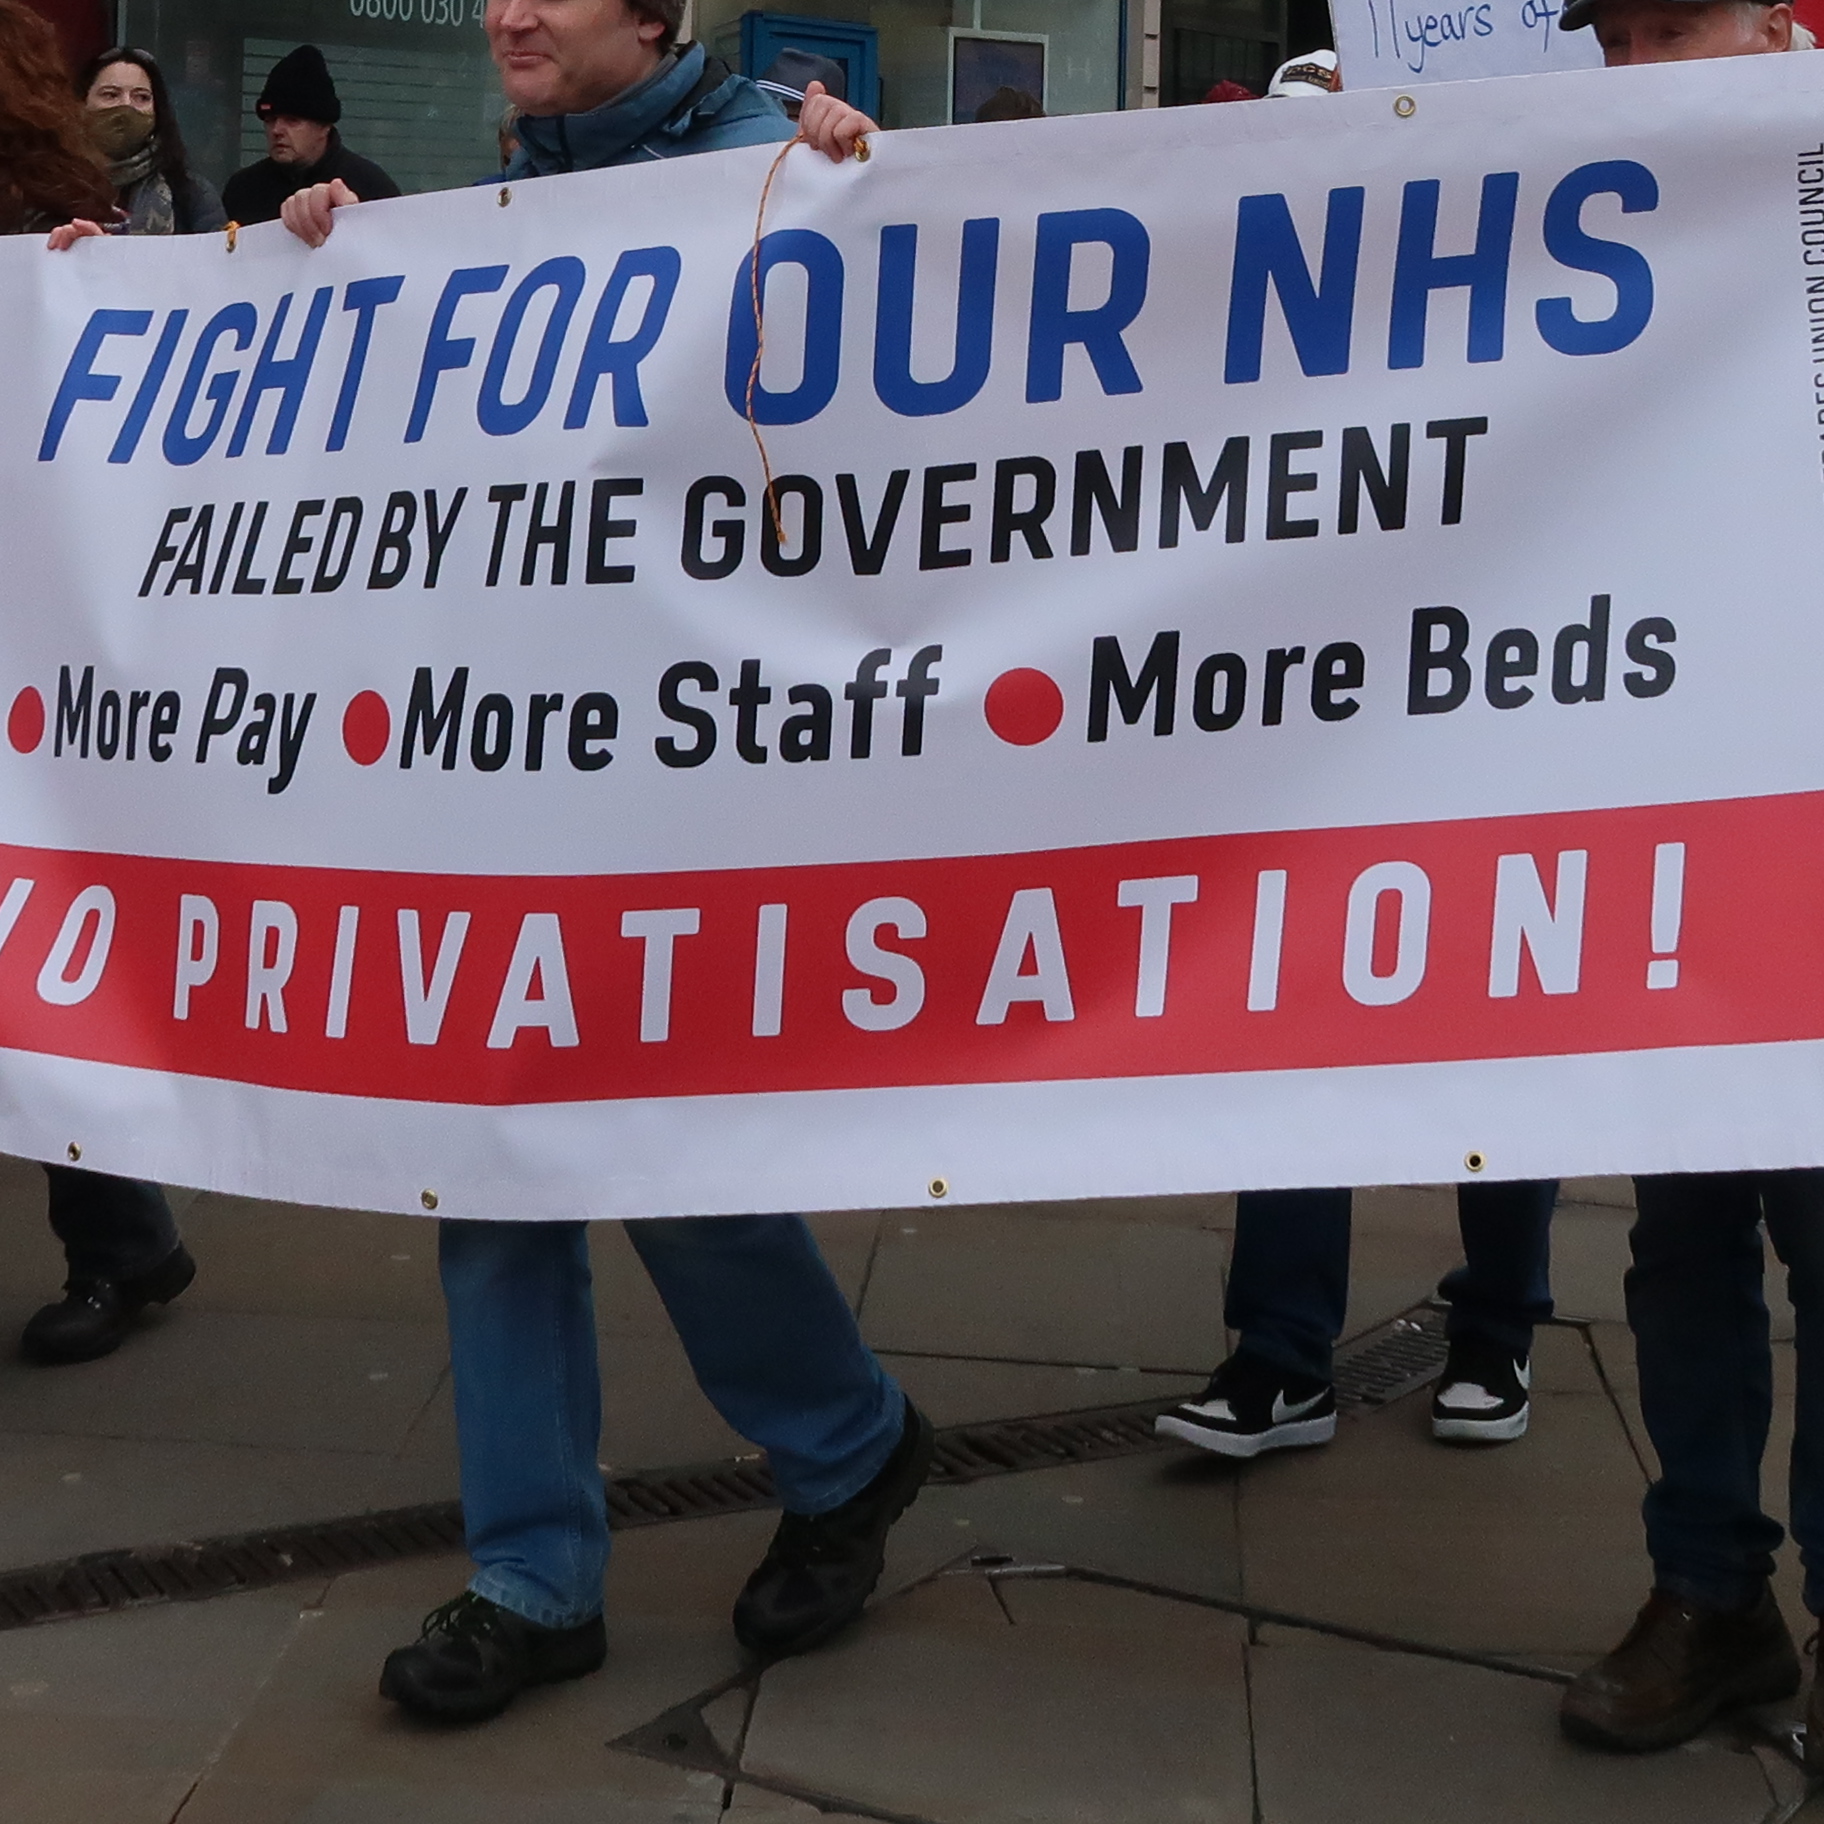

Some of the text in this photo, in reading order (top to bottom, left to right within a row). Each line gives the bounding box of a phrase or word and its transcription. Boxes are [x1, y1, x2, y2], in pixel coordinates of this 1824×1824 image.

[1402, 0, 1495, 74] years
[36, 158, 1659, 467] FIGHT FOR OUR NHS
[137, 415, 1488, 598] FAILED BY THE GOVERNMENT
[54, 664, 317, 796] More Pay
[398, 643, 945, 773] More Staff
[1086, 593, 1678, 744] More Beds
[172, 840, 1686, 1052] PRIVATISATION!
